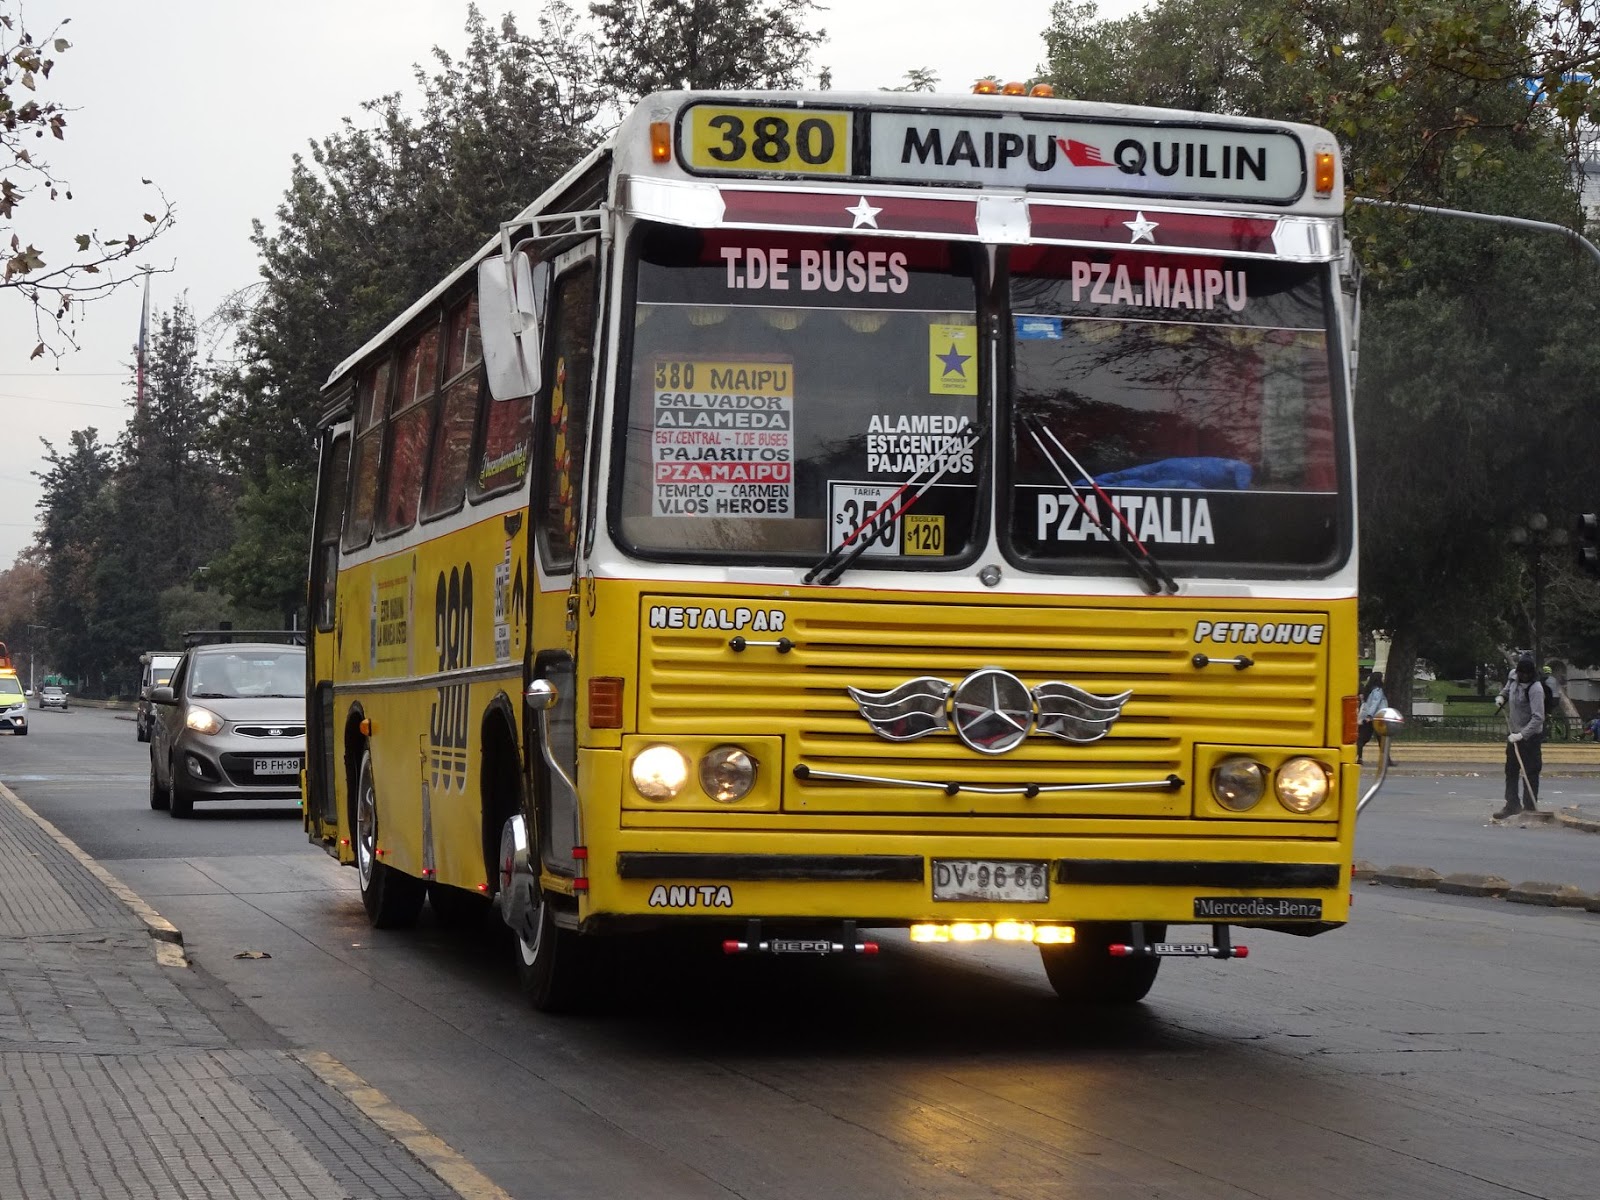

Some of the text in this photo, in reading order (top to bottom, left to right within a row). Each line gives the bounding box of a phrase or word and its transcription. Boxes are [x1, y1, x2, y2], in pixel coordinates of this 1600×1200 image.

[708, 114, 835, 165] 380
[901, 127, 1267, 181] MAIPU QUILIN
[720, 246, 910, 295] T.DE BUSES
[1071, 261, 1248, 311] PZA.MAIPU
[655, 362, 787, 391] 380 MAIPU
[659, 393, 783, 410] SALVADOR
[657, 411, 787, 428] ALAMEDA
[656, 431, 722, 445] EST.CENTRAL
[758, 433, 788, 446] BUSES
[659, 447, 790, 461] PAJARITOS
[657, 465, 788, 481] PZA.MAIPU
[657, 484, 714, 498] TEMPLO
[731, 484, 789, 498] CARMEN
[853, 487, 881, 497] TARIFA
[658, 498, 789, 514] V.LOS HEROES
[649, 605, 787, 632] METALPAR
[1194, 621, 1325, 645] PETROHUE
[649, 885, 734, 908] ANITA
[1199, 898, 1318, 917] Mercedes-Benz
